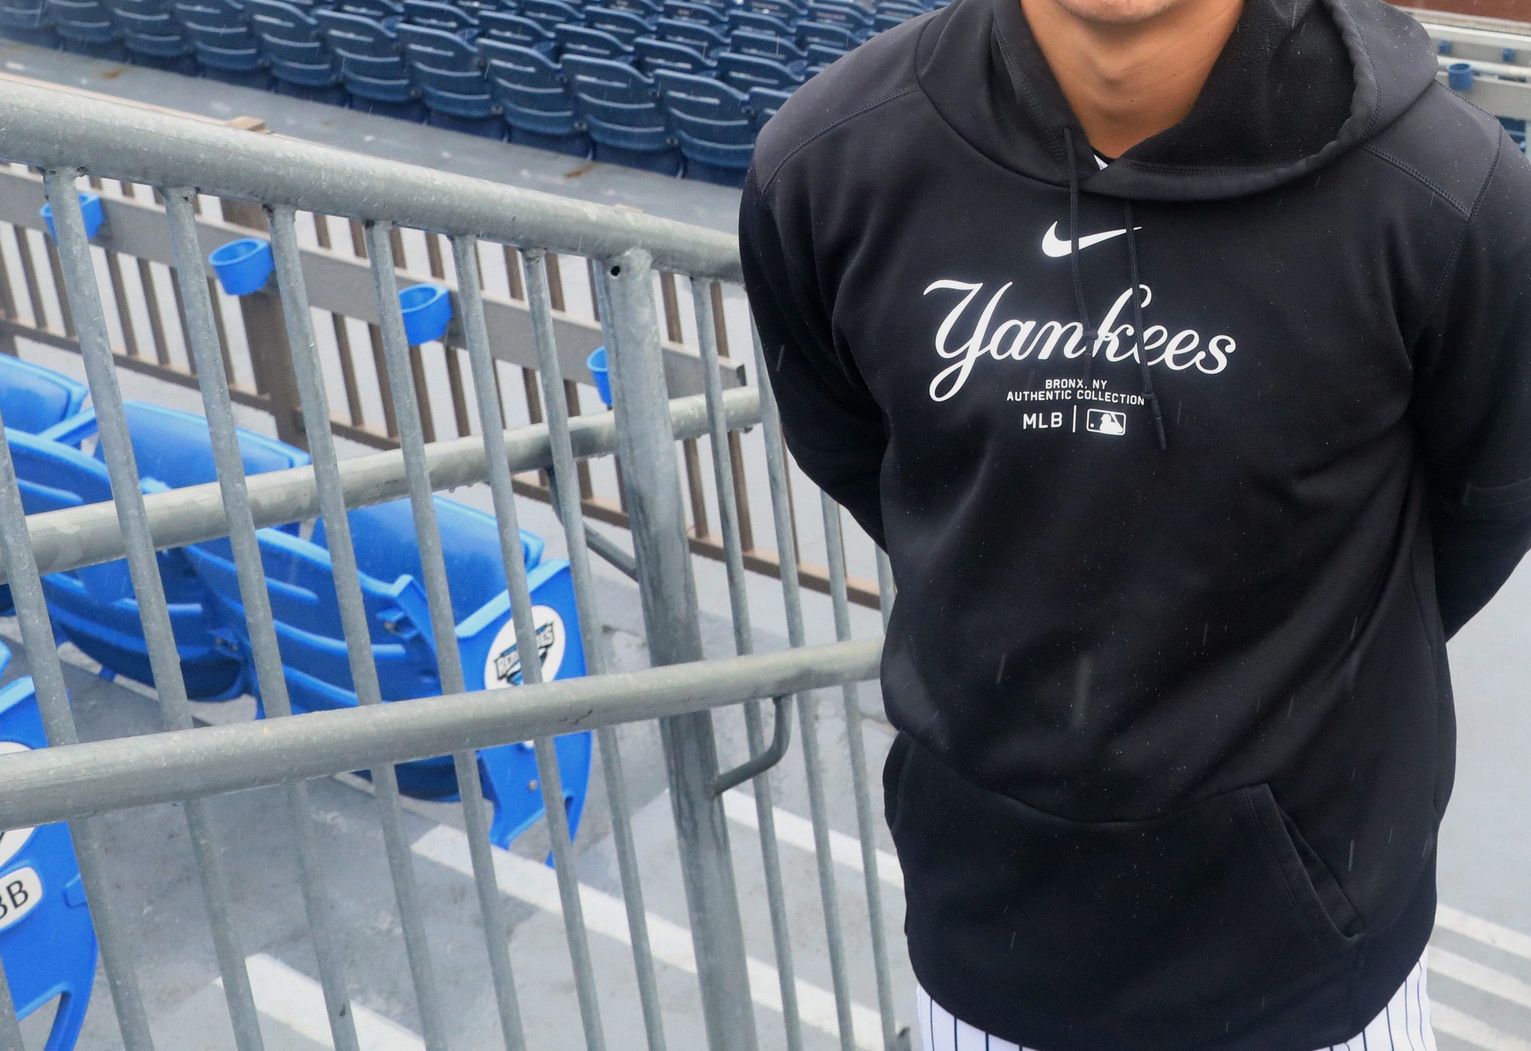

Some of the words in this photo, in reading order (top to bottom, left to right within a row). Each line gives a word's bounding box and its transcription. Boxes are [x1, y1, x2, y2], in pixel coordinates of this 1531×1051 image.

[923, 279, 1236, 402] Yankees
[1045, 379, 1088, 390] BRONX,
[1092, 379, 1107, 390] NY
[1006, 390, 1072, 402] AUTHENTIC
[1076, 390, 1145, 406] COLLECTION
[1022, 412, 1063, 430] MLB
